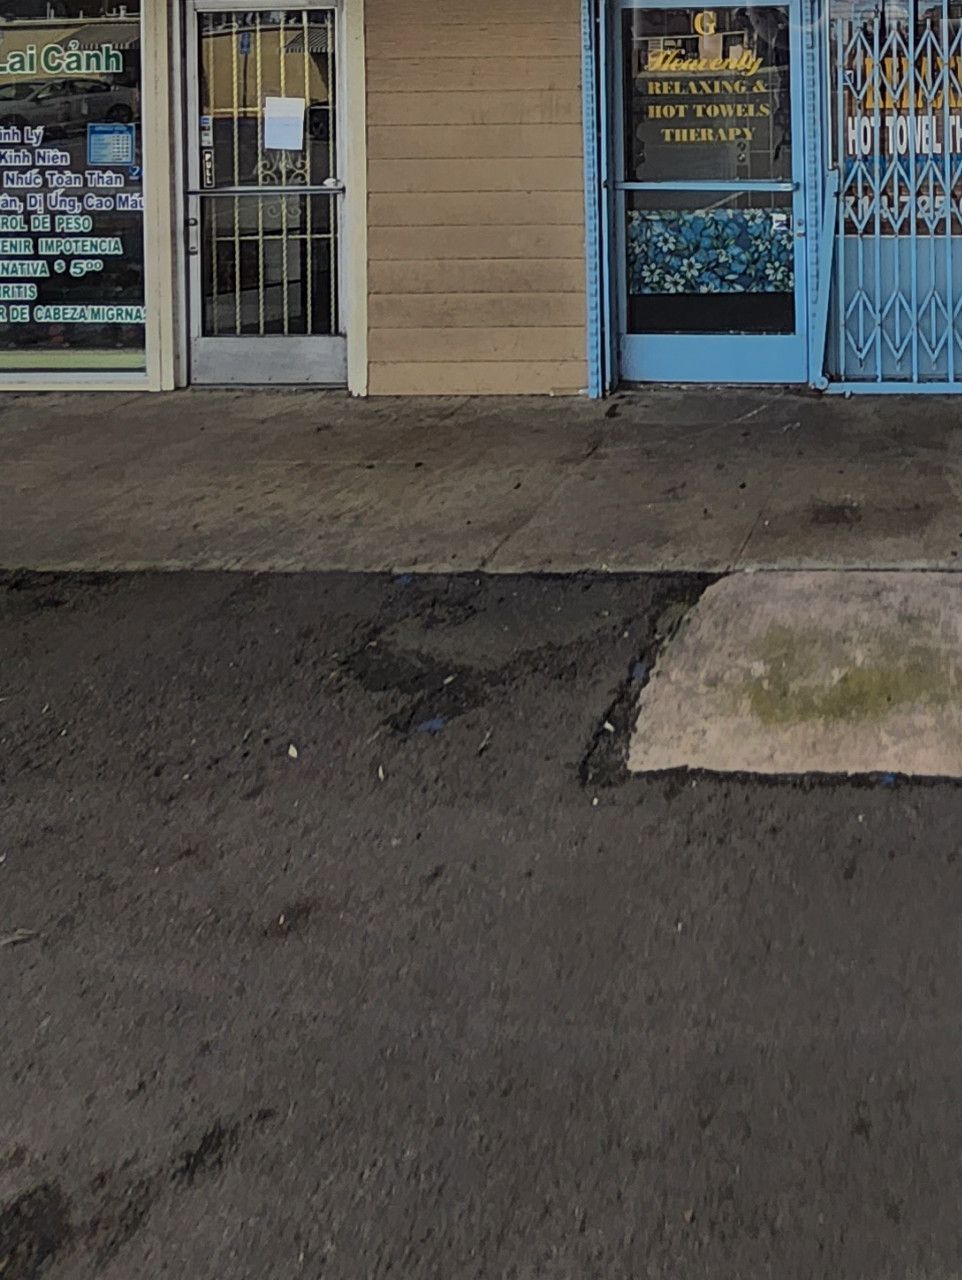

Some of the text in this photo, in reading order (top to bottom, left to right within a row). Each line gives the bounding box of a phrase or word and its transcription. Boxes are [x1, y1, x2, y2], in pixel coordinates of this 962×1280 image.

[41, 40, 123, 74] Cảnh
[645, 49, 763, 76] Heavenly
[648, 80, 767, 95] RELAXING &
[648, 103, 771, 119] HOT TOWELS
[661, 127, 755, 142] THERAPY
[848, 116, 880, 155] HOT
[35, 148, 70, 166] Niên
[85, 170, 124, 188] Thân
[84, 194, 114, 210] Cao
[31, 215, 51, 231] DE
[55, 215, 92, 232] PESO
[38, 238, 123, 254] IMPOTENCIA
[9, 306, 30, 322] DE
